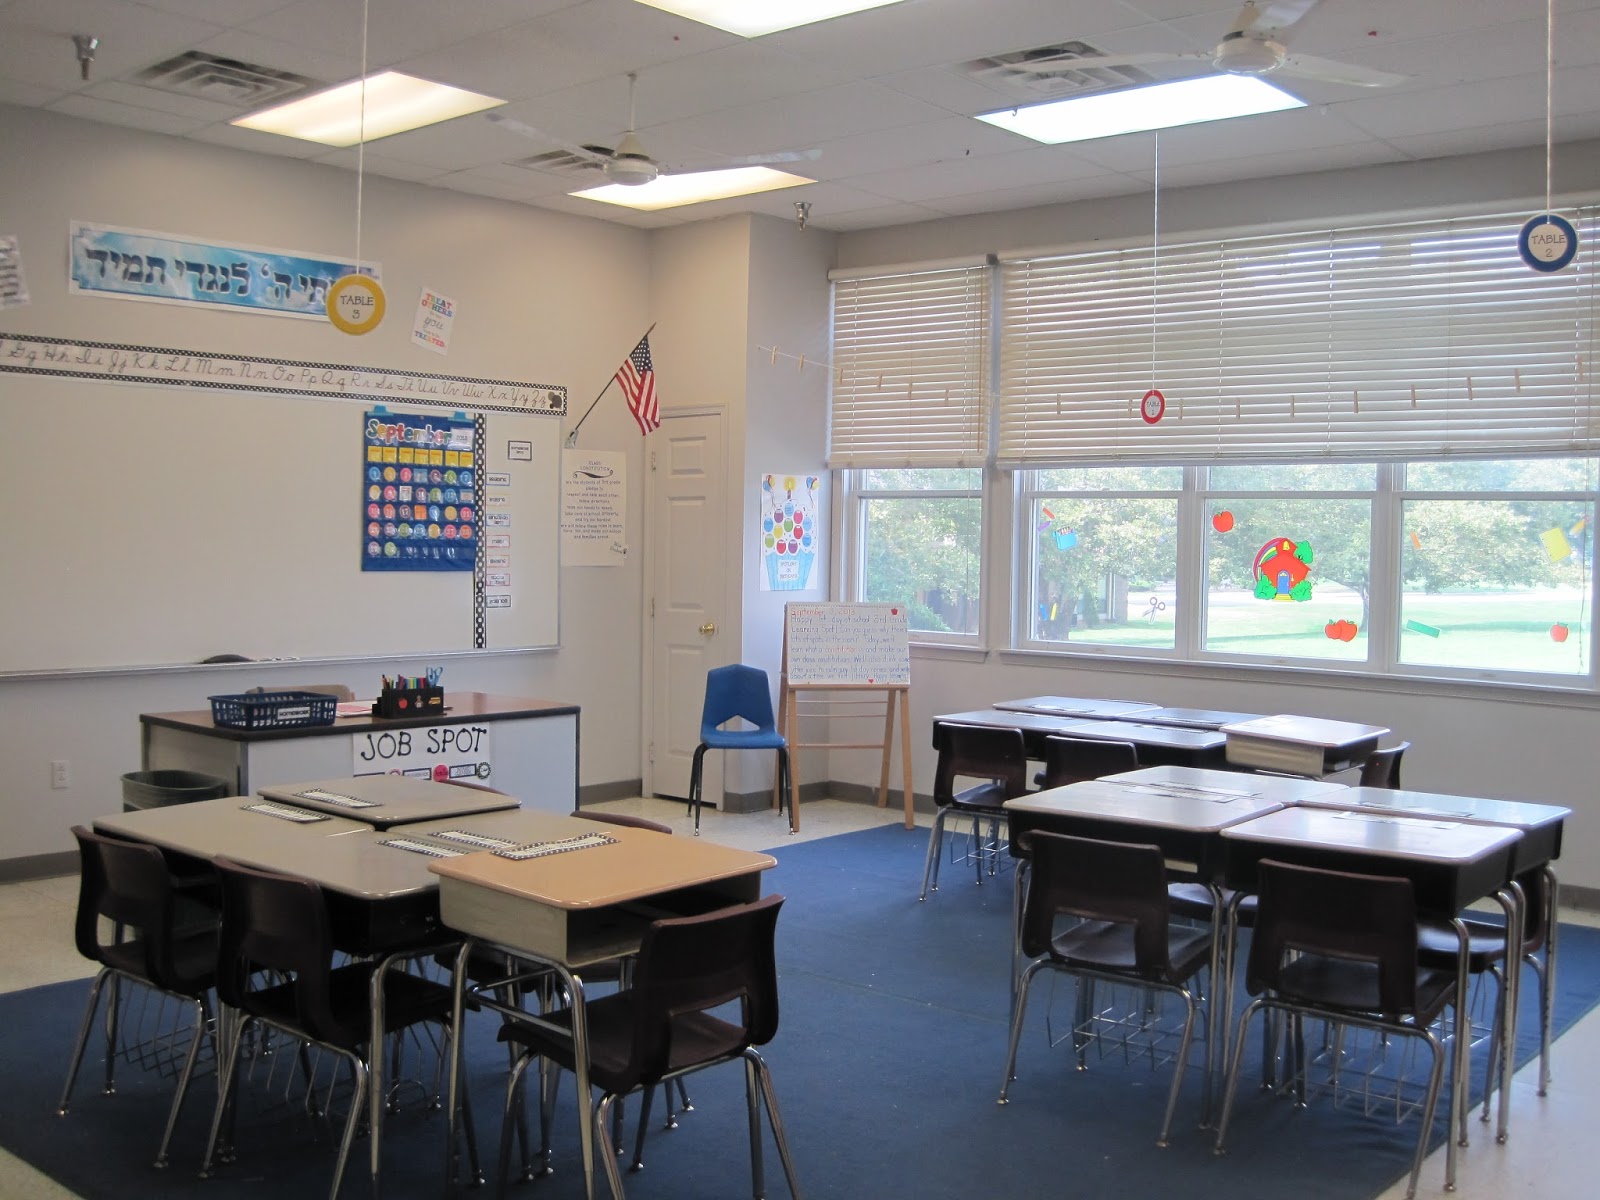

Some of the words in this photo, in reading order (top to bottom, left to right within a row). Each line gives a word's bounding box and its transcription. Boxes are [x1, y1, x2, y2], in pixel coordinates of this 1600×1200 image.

[1531, 234, 1566, 244] TABLE
[1545, 248, 1553, 258] 2
[85, 248, 167, 285] תמיד
[174, 258, 250, 295] לנגדי
[340, 295, 374, 306] TABLE
[426, 292, 452, 309] TREAT
[352, 309, 360, 319] 3
[422, 299, 453, 318] OTHERS
[423, 316, 443, 330] you
[1147, 400, 1160, 408] TABLE
[366, 419, 452, 444] September
[361, 731, 412, 761] JOB
[427, 727, 487, 754] SPOT
